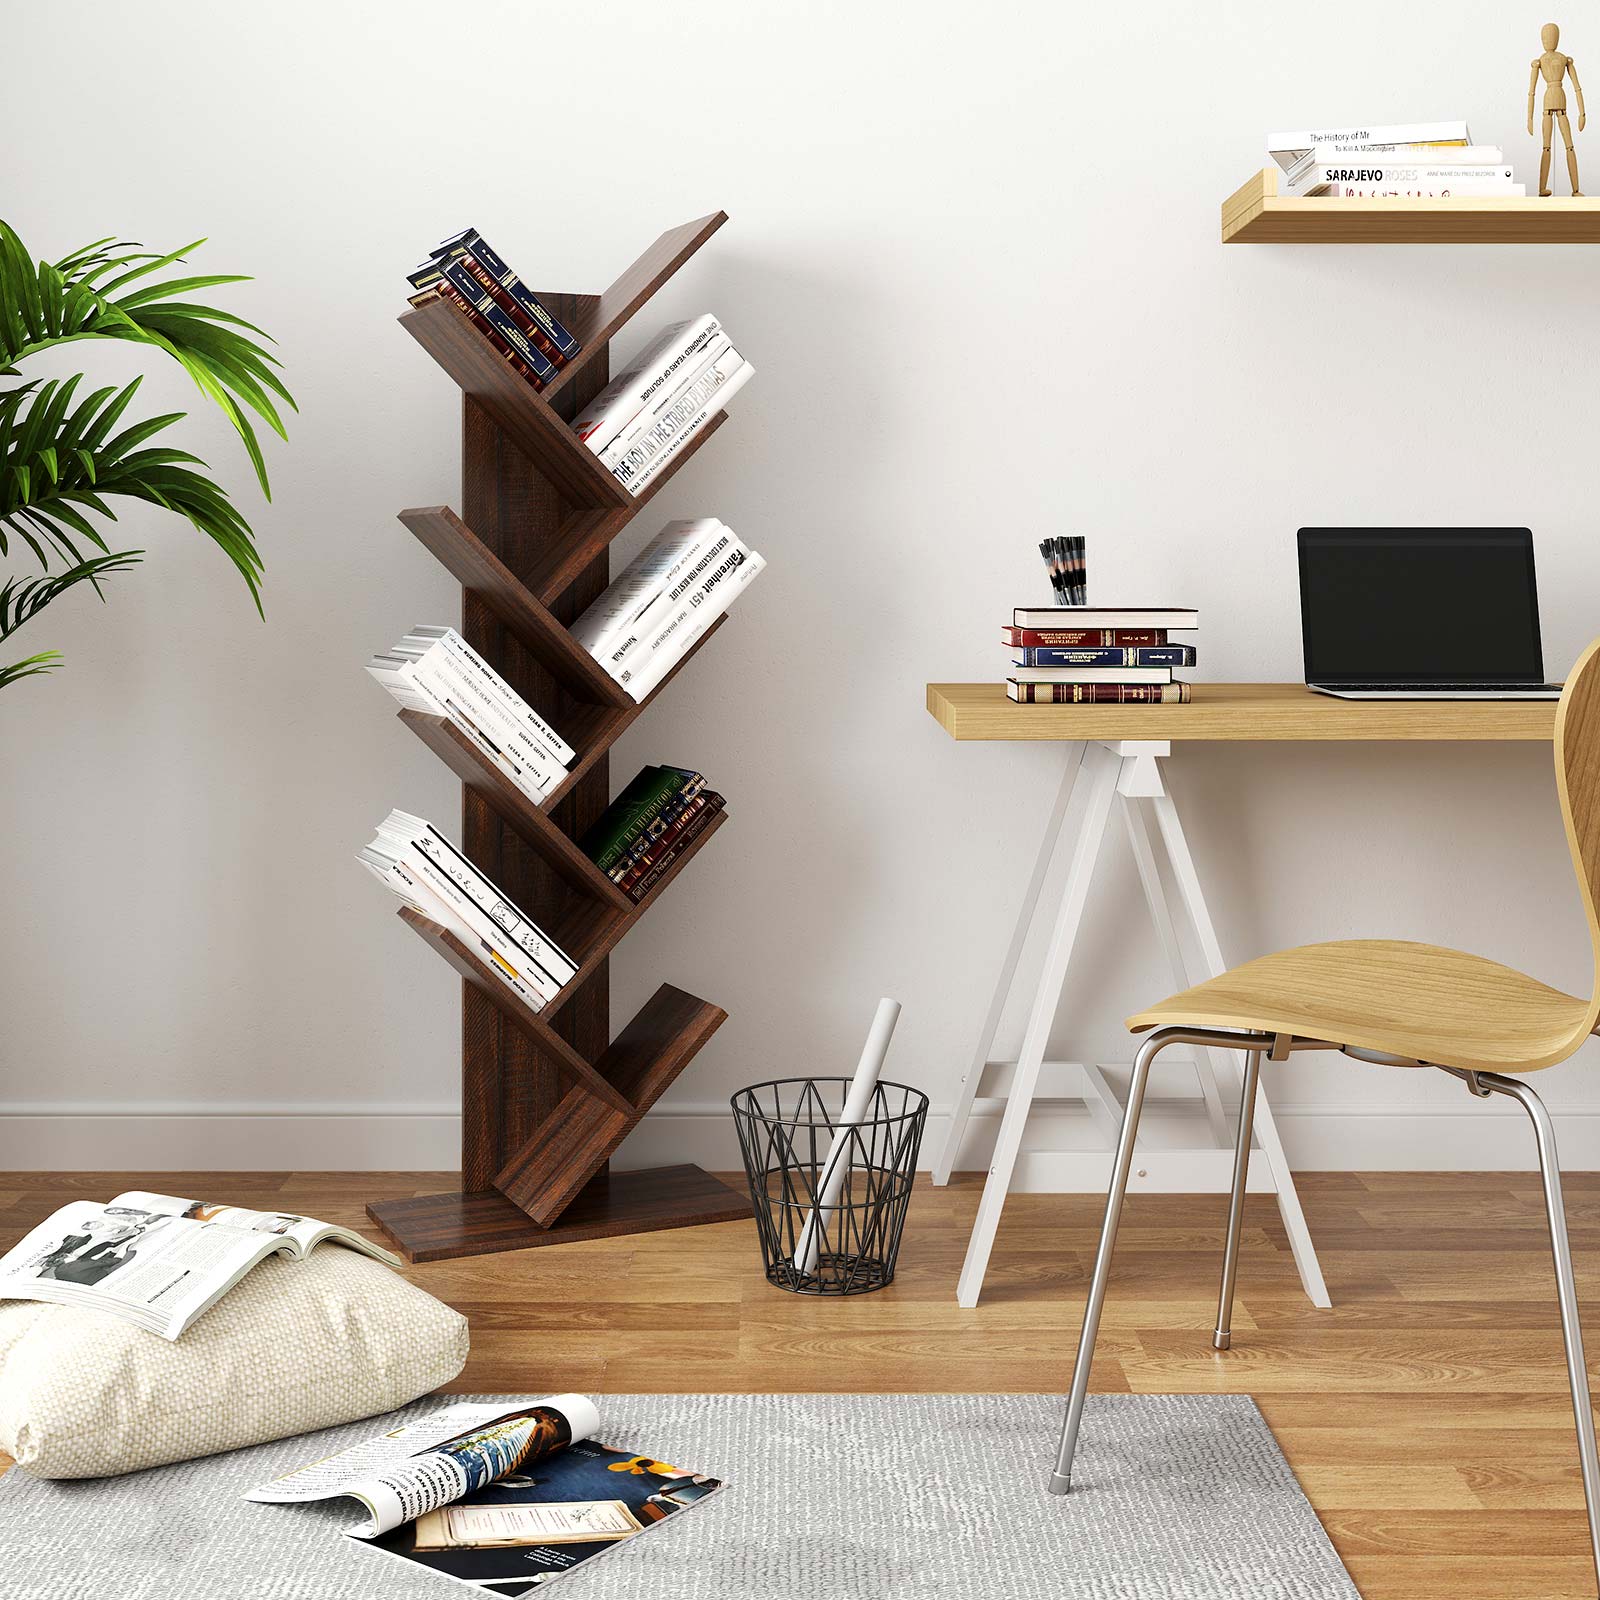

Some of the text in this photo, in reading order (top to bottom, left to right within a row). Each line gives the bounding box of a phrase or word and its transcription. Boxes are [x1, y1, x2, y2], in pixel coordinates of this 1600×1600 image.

[1310, 131, 1370, 142] The History of Mr
[1326, 169, 1383, 181] SARAJEVO
[1385, 170, 1418, 181] ROSES
[706, 322, 717, 334] ONE
[685, 332, 707, 356] HUNDRED
[669, 355, 686, 371] YEARS
[664, 370, 671, 379] OF
[640, 377, 664, 401] SOLITUDE
[612, 461, 634, 483] THE
[627, 446, 647, 470] BOY
[640, 438, 657, 456] IN
[649, 423, 670, 446] THE
[662, 397, 695, 432] STRIPED
[686, 364, 725, 406] PYJAMAS
[716, 537, 728, 550] BEST
[695, 547, 719, 573] EDUCATION
[687, 570, 698, 581] FOR
[702, 549, 744, 593] Fahrenheit
[678, 578, 690, 592] BEST
[669, 589, 680, 601] LIFE
[689, 592, 704, 608] 451
[677, 611, 687, 622] RAY
[652, 621, 677, 650] BRADBURY
[481, 668, 492, 680] HOME
[528, 714, 541, 728] SUSAN
[546, 733, 561, 749] GEFFEN
[508, 744, 520, 757] SUSAN
[526, 763, 540, 777] GEFFEN
[420, 838, 441, 858] MY
[436, 1464, 450, 1481] PHILO
[415, 1475, 426, 1488] SAN
[438, 1477, 446, 1498] NAPA
